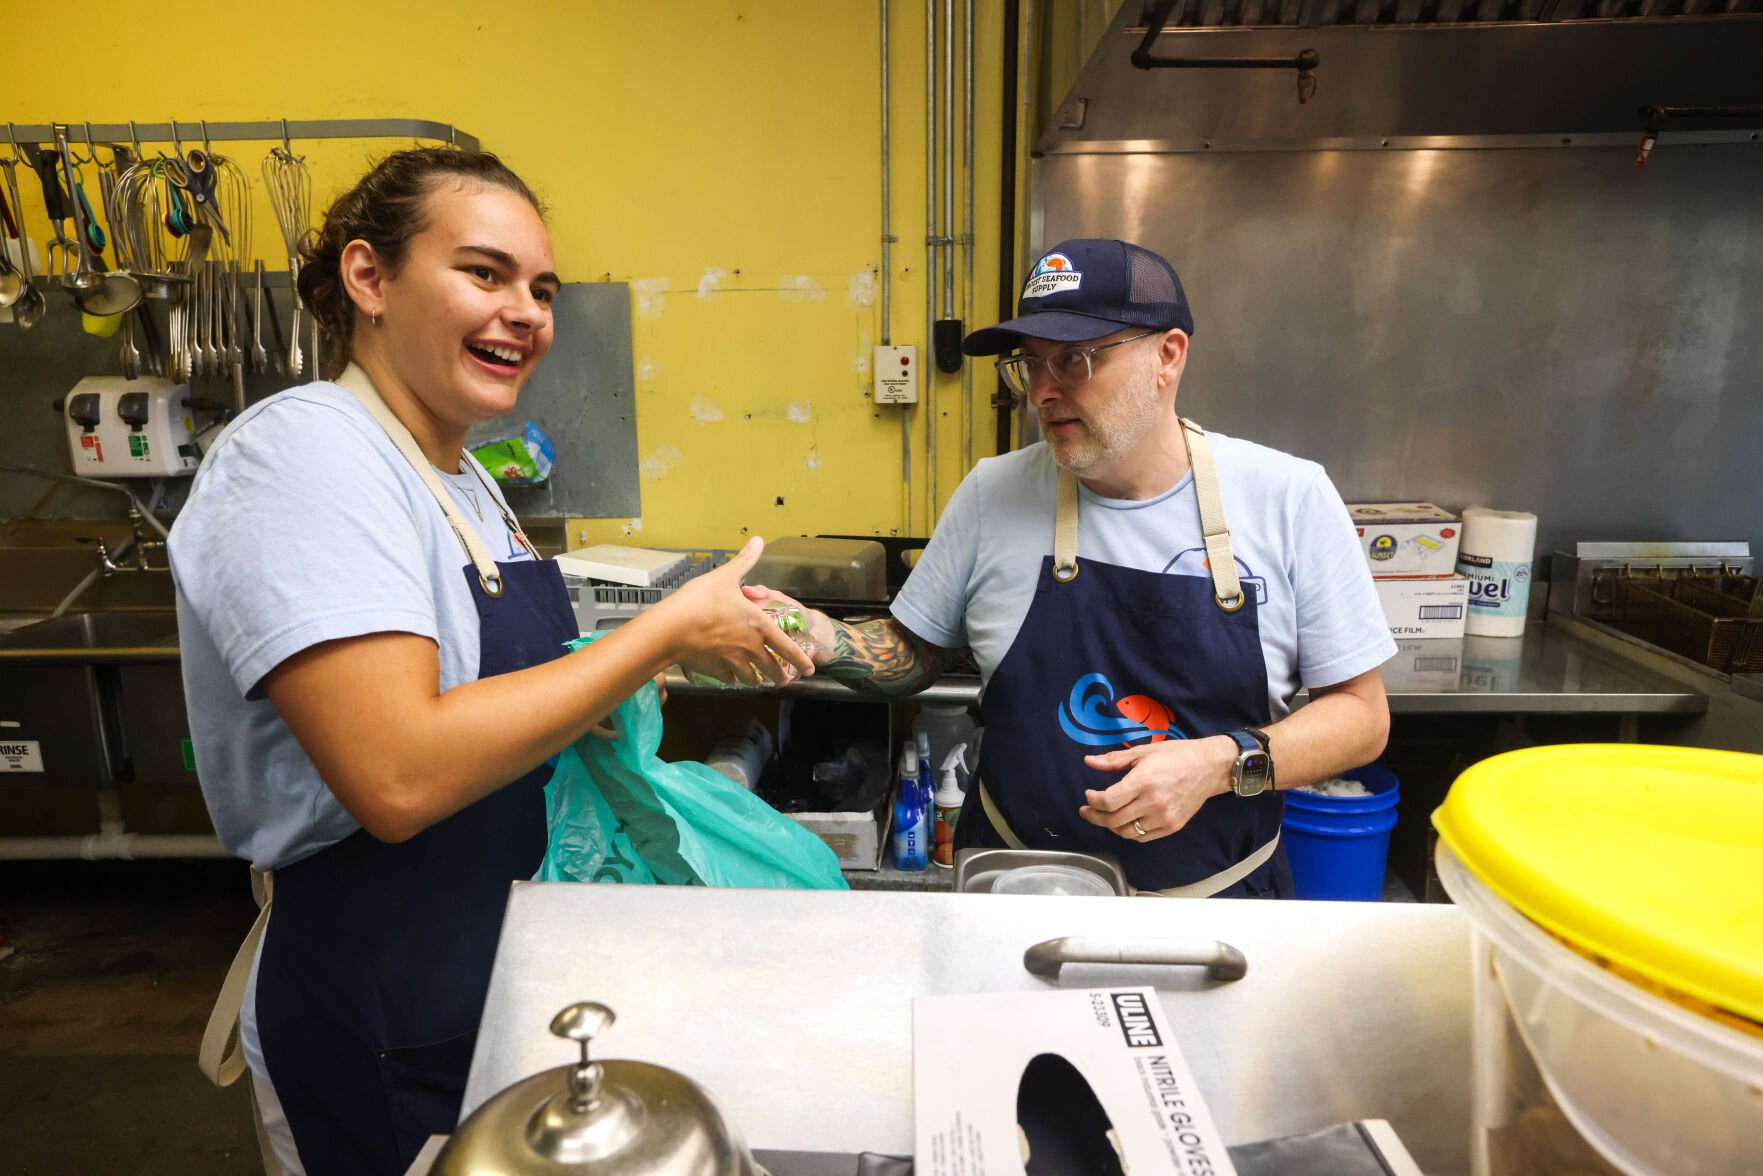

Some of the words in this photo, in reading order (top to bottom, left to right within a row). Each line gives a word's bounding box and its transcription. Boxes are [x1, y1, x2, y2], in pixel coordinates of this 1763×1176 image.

[1031, 283, 1057, 294] SUPPLY
[1371, 551, 1393, 560] SUNSET
[1404, 626, 1422, 634] FILM
[1116, 994, 1158, 1047] ULINE
[1147, 1055, 1185, 1107] NITRILE
[1170, 1111, 1215, 1176] GLOVES
